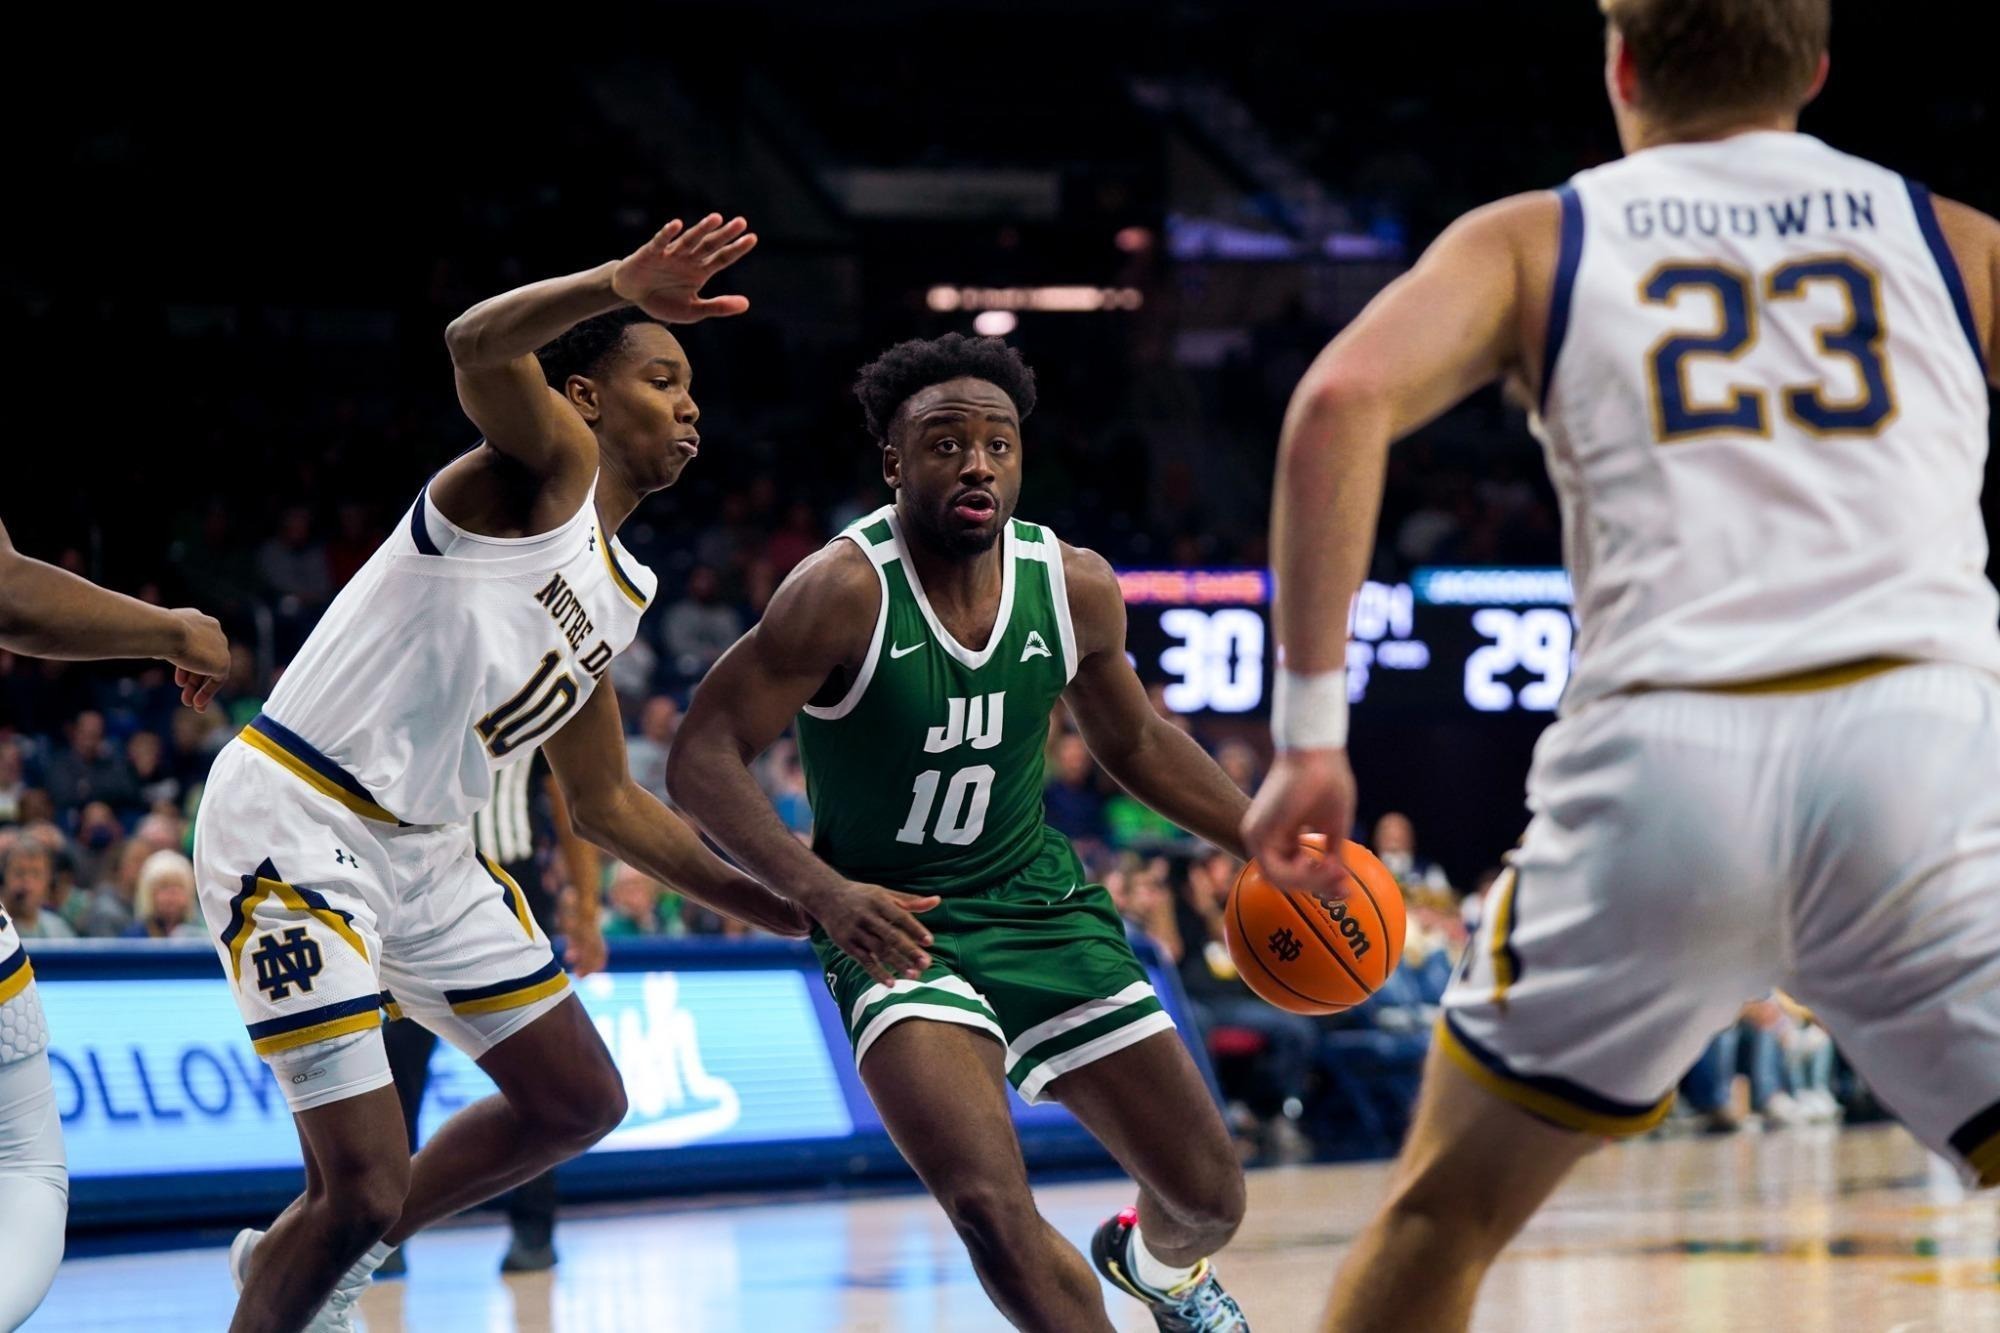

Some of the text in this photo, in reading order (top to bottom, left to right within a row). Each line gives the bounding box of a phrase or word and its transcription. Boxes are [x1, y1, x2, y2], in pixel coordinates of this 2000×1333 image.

[1624, 188, 1878, 238] GOODWIN
[1637, 252, 1898, 443] 23
[534, 571, 613, 681] NOTRE D
[1158, 608, 1265, 713] 30
[1464, 608, 1572, 713] 29
[473, 647, 580, 758] 10
[923, 690, 1007, 753] JU
[895, 763, 996, 846] 10
[1312, 889, 1372, 961] son
[47, 1047, 272, 1123] OLLO
